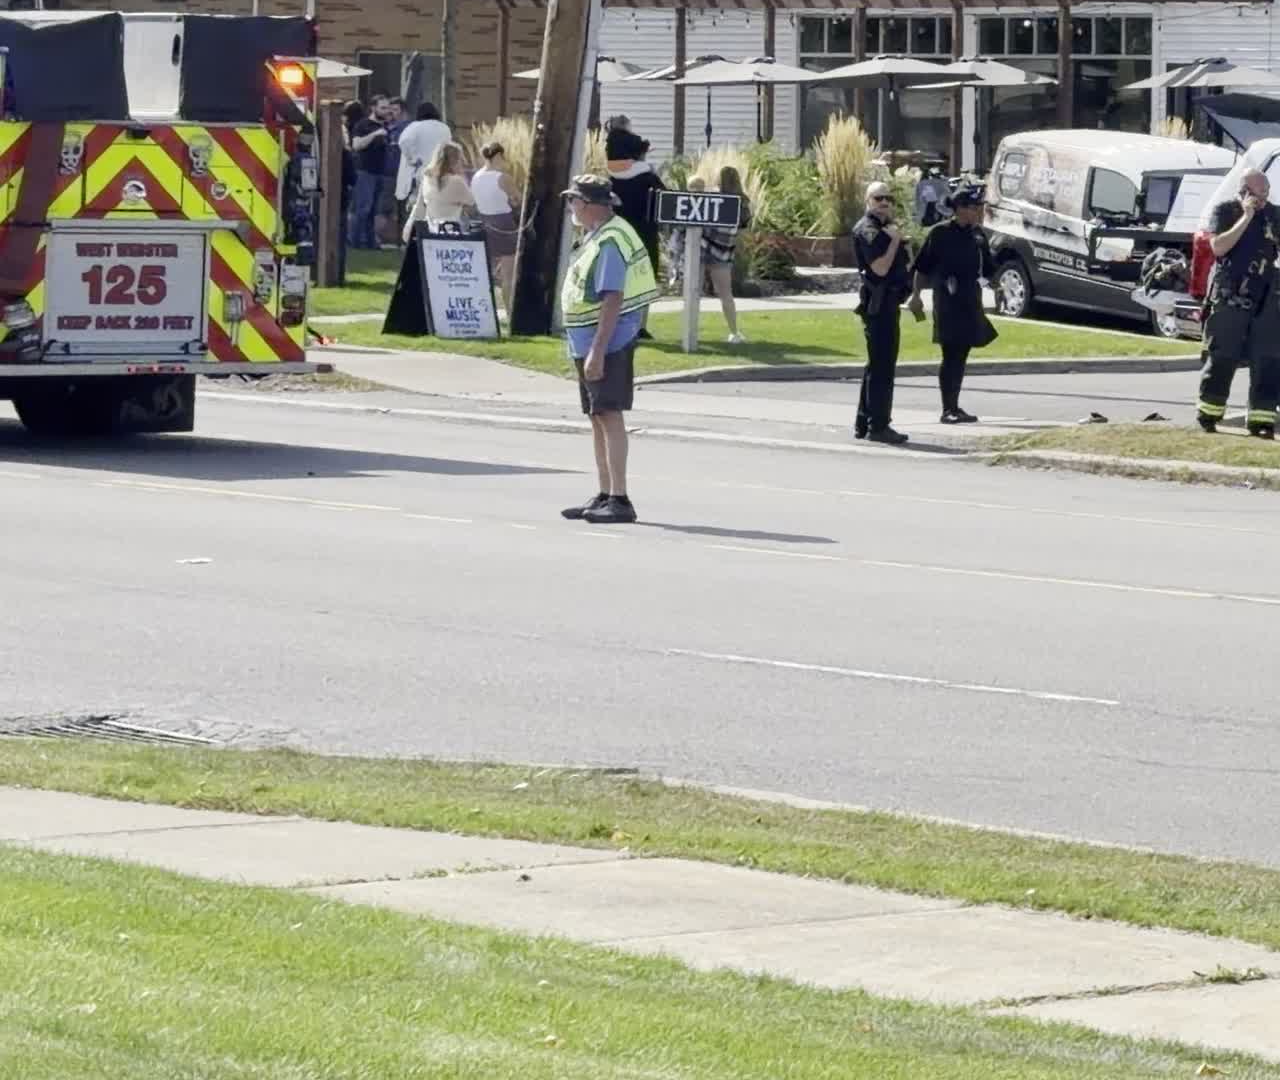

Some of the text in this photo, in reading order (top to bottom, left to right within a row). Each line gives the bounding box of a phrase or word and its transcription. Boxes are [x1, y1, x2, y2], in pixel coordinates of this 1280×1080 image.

[675, 195, 724, 222] EXIT
[76, 243, 178, 258] WEST WEBSTER
[436, 248, 473, 260] HAPPY
[441, 262, 473, 274] HOUR
[81, 264, 167, 305] 125
[446, 309, 480, 322] MUSIC
